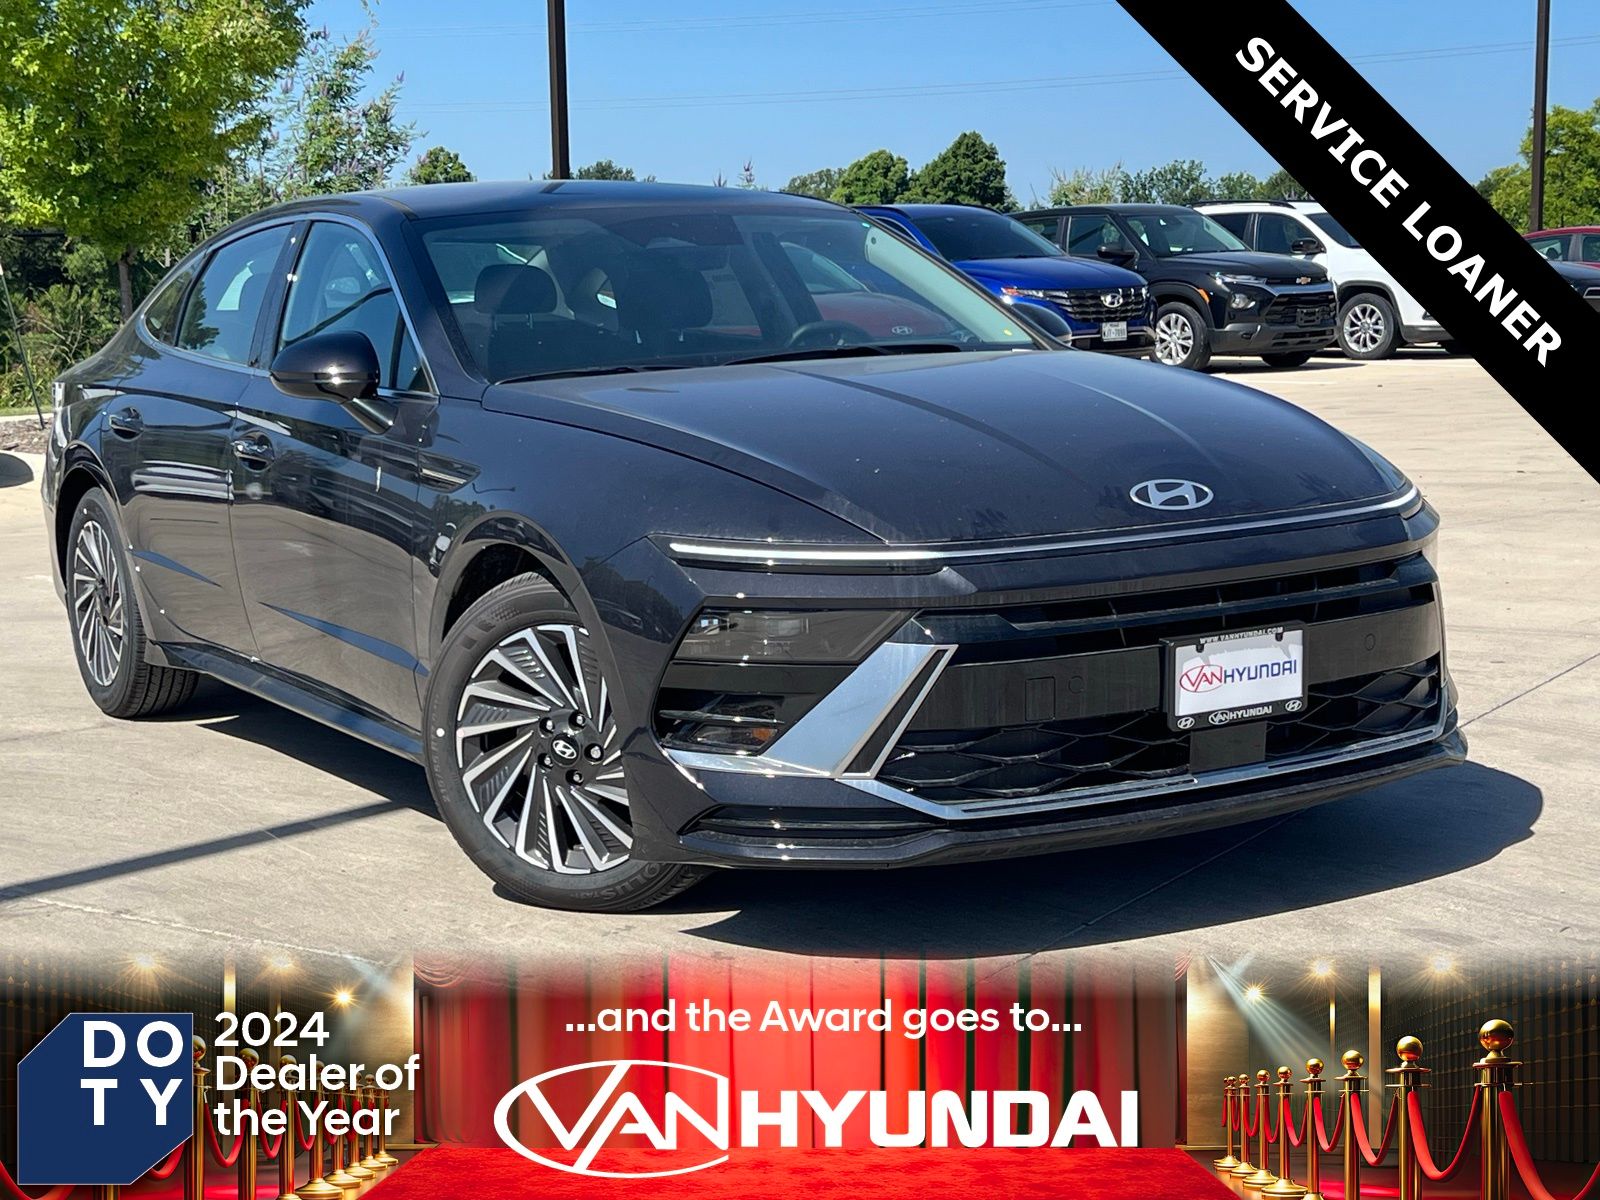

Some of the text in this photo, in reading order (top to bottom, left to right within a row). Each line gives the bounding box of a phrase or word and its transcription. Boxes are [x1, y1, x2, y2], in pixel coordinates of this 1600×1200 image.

[1183, 659, 1297, 692] VAN HYUNDAI
[1230, 705, 1272, 720] HYUNDAI
